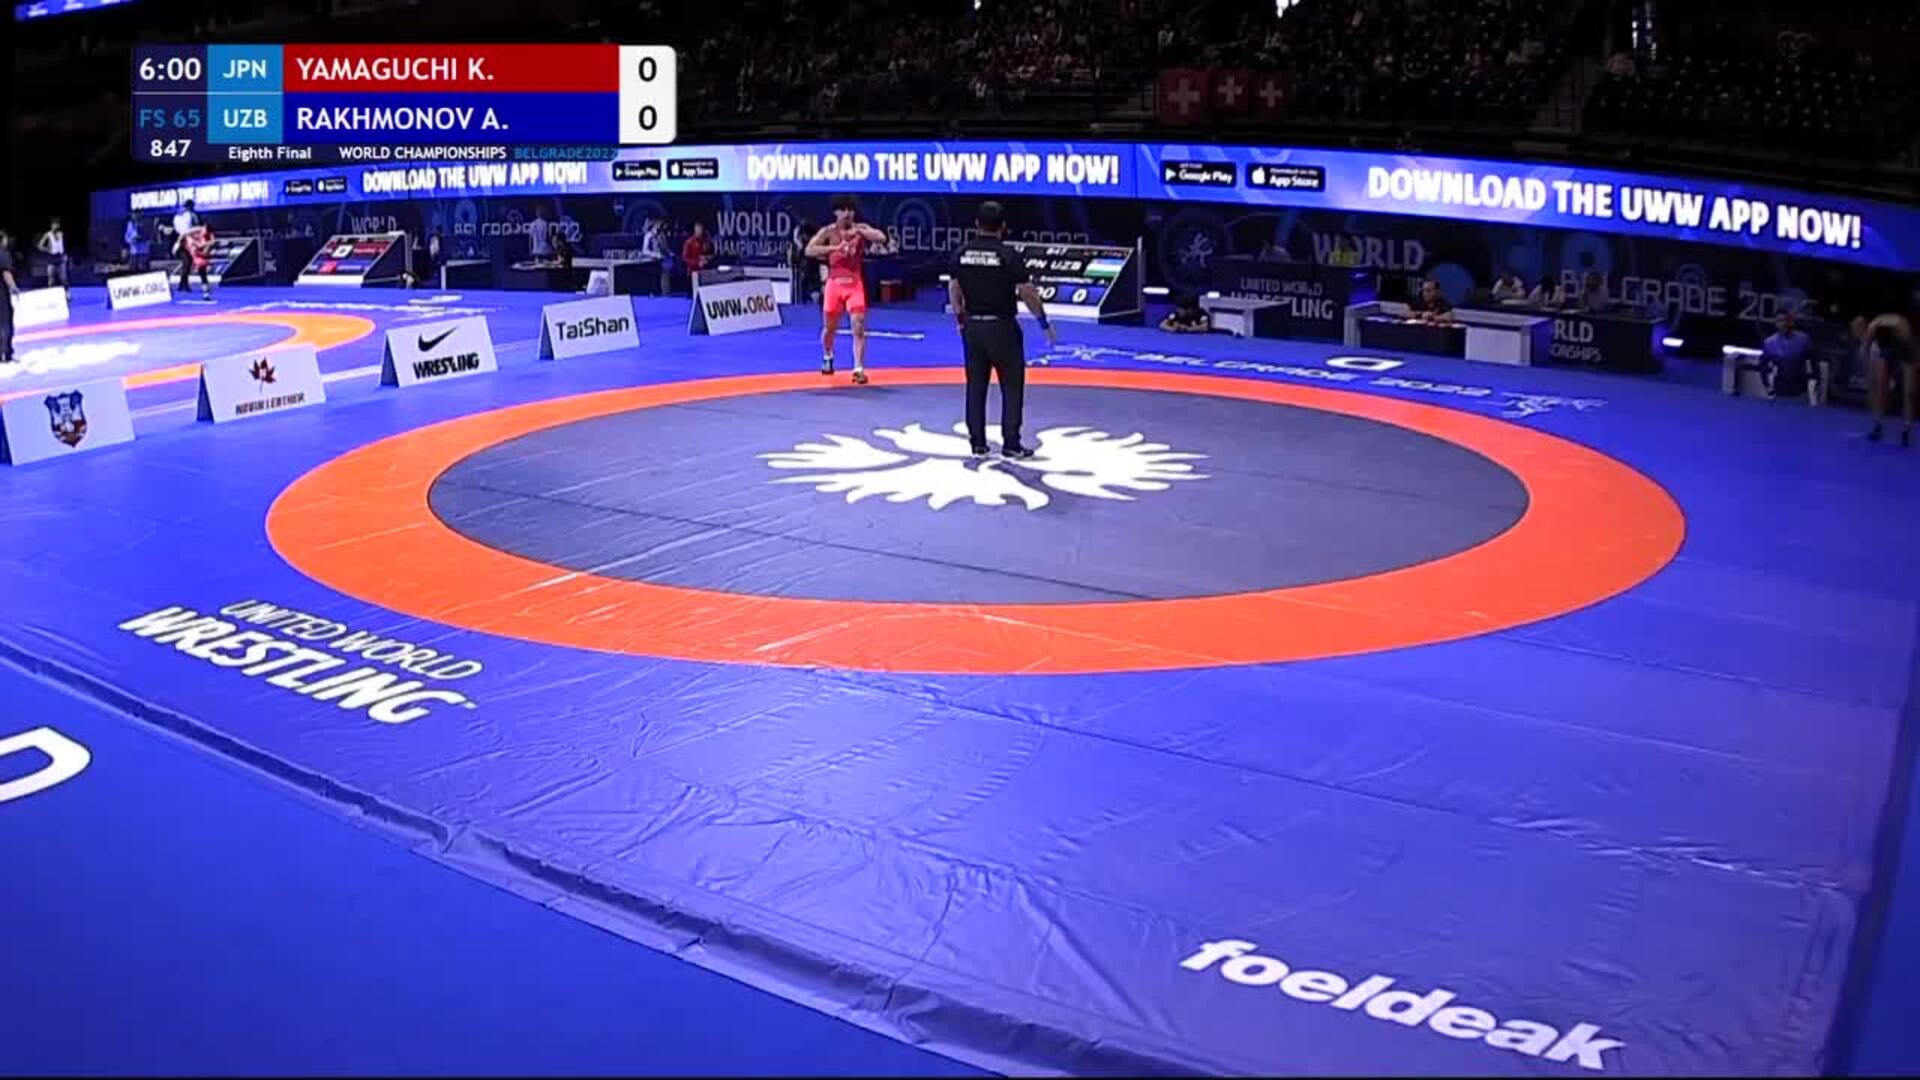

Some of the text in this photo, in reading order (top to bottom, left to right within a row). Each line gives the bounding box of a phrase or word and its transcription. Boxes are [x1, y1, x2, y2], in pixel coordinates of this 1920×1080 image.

[363, 168, 435, 192] DOWNLOAD
[439, 168, 466, 189] THE
[468, 164, 507, 187] UWW
[510, 162, 538, 186] APP
[543, 161, 588, 185] NOW!
[747, 153, 1119, 185] DOWNLOAD THE UWW APP NOW!
[1179, 169, 1233, 183] Google Play
[1269, 175, 1319, 188] App Store
[1368, 167, 1861, 249] DOWNLOAD THE UWW APP NOW!
[717, 211, 791, 236] WORLD
[1050, 260, 1082, 271] UZB
[706, 295, 775, 320] UWW.ORG
[1072, 288, 1088, 303] 0
[555, 316, 630, 341] TaiShan
[412, 352, 480, 380] WRESTLING
[219, 599, 484, 680] UNITED WORLD
[116, 606, 470, 724] WRESTLING
[1179, 938, 1627, 1071] foeldeak
